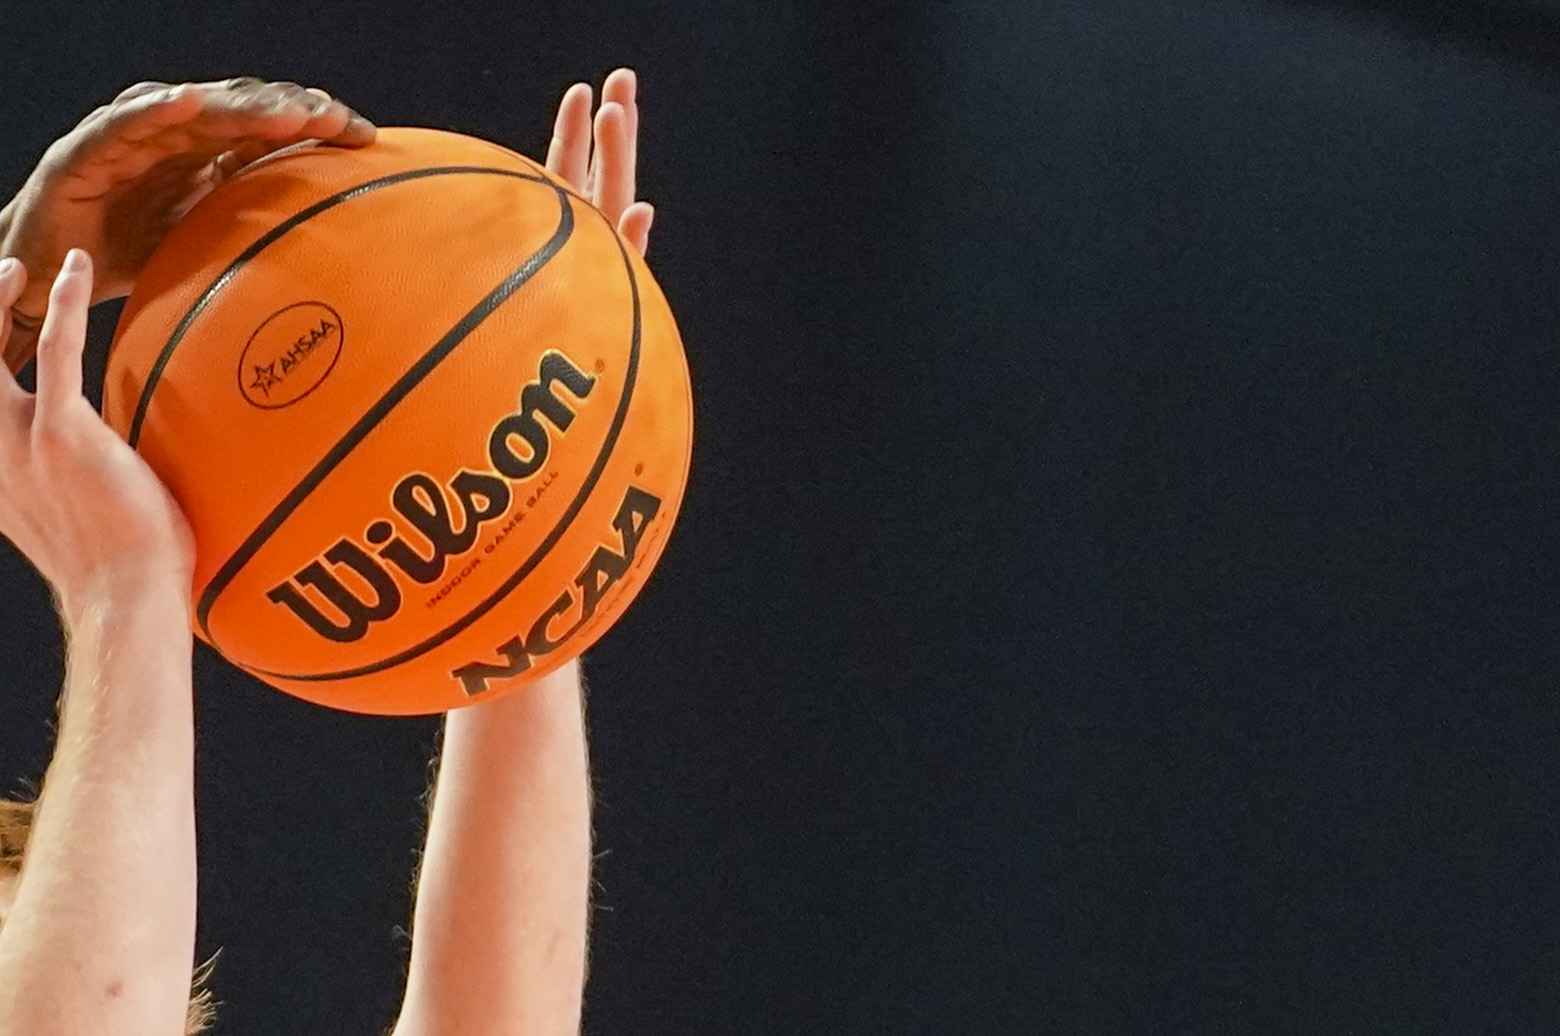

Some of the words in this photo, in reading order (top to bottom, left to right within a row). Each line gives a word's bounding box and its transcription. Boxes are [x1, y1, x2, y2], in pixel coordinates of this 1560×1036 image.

[280, 319, 337, 374] AHSAA
[265, 347, 598, 644] Wilson
[425, 557, 481, 608] INDOOR
[483, 511, 527, 554] GAME
[525, 471, 559, 508] BALL
[449, 484, 663, 696] NCAA
